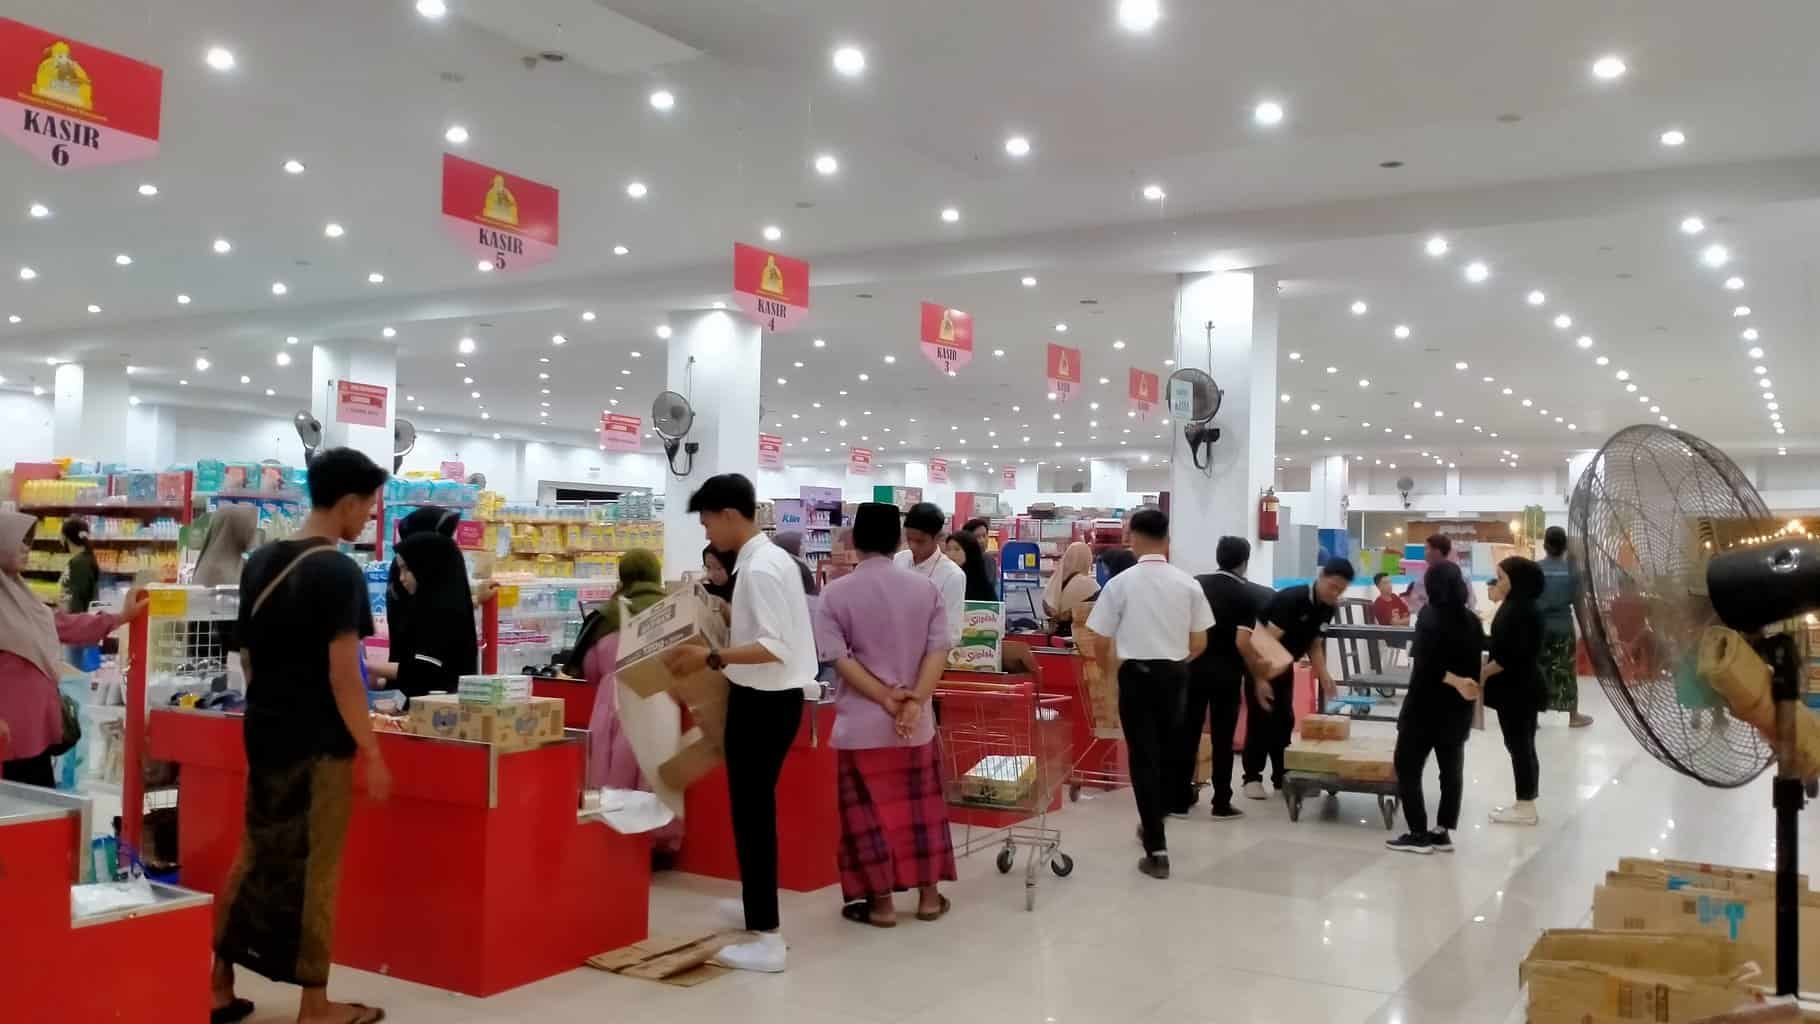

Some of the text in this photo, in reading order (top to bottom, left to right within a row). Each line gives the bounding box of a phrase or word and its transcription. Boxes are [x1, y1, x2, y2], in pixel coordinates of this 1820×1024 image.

[24, 108, 100, 150] KASIR
[51, 143, 70, 167] 6
[479, 227, 524, 256] KASIR
[495, 251, 506, 270] 5
[757, 298, 787, 319] KASIR
[767, 316, 775, 332] 4
